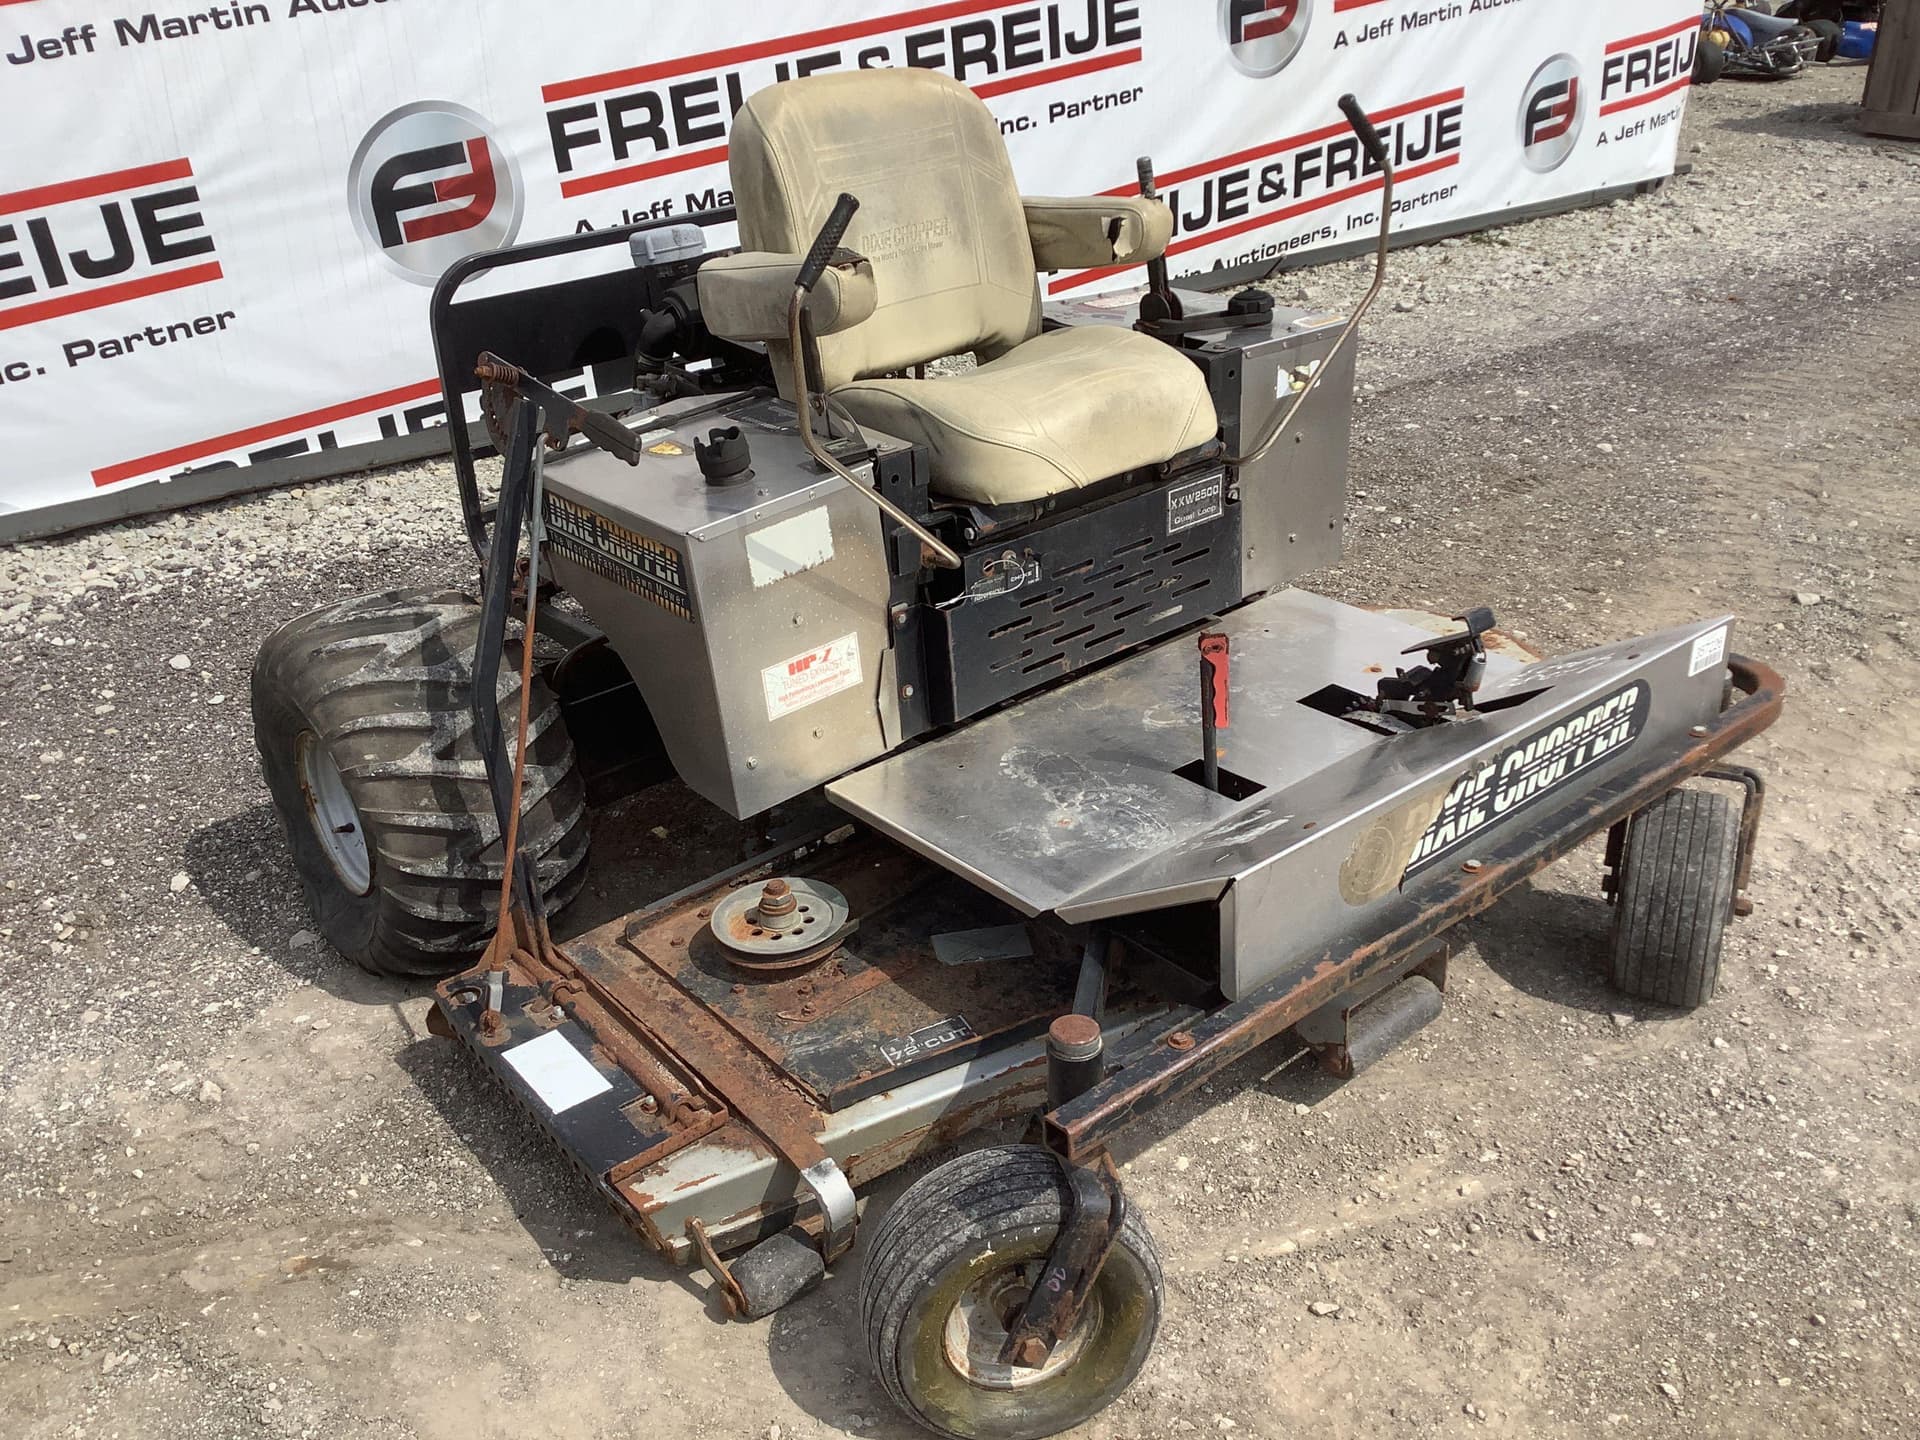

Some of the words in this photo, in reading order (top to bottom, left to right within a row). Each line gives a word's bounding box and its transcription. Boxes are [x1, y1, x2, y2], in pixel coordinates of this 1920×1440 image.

[6, 24, 97, 65] Jeff
[113, 0, 271, 47] Martin
[1333, 31, 1349, 50] A
[1356, 18, 1394, 43] Jeff
[1401, 1, 1462, 32] Martin
[1049, 86, 1144, 123] Partner
[1258, 163, 1287, 203] &
[1293, 104, 1464, 199] FREIJE
[1596, 131, 1609, 147] A
[1614, 119, 1646, 141] Jeff
[1346, 211, 1380, 231] Inc.
[1389, 183, 1458, 217] Partner
[62, 310, 236, 367] Partner
[1171, 484, 1219, 510] XXW2500
[549, 492, 595, 545] DIXIE
[595, 517, 681, 587] CHOPPER
[1493, 686, 1640, 813] CHOPPER
